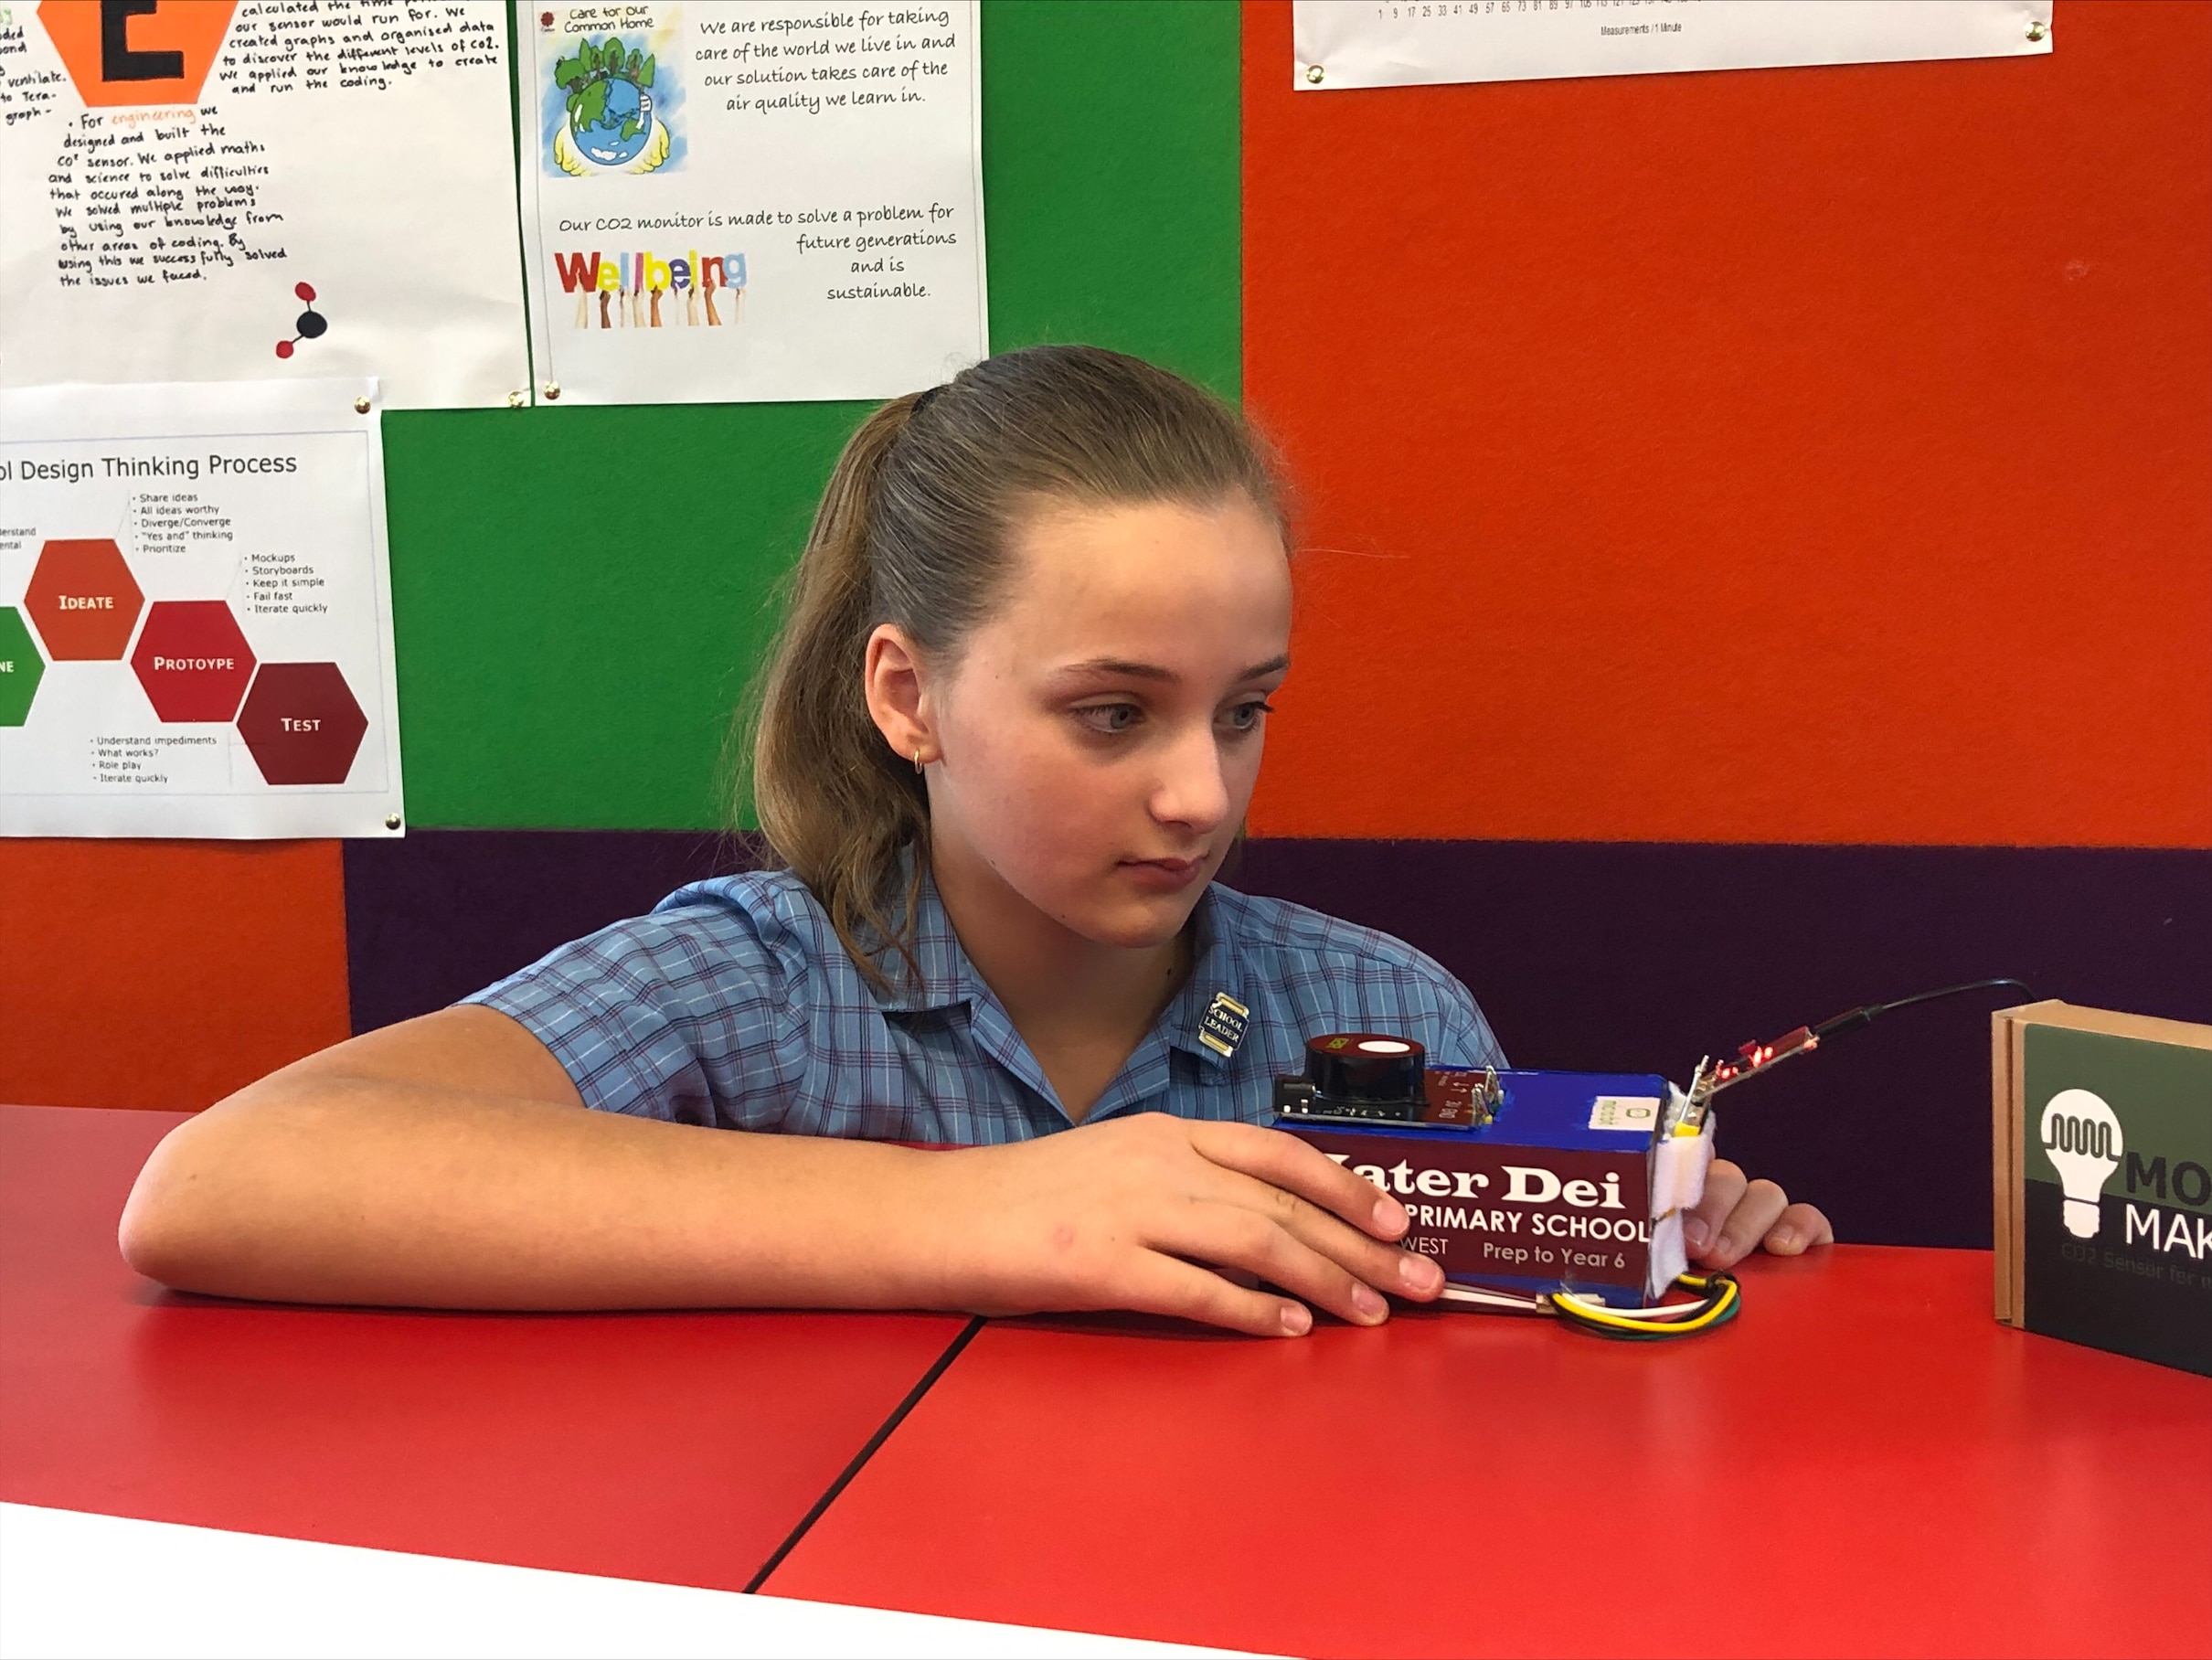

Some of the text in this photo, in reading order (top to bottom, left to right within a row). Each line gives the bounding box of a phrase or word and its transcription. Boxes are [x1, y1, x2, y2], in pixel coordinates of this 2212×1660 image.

[241, 2, 319, 17] calculated
[569, 8, 598, 19] Care
[602, 7, 622, 17] for
[235, 15, 399, 33] our sensor would run
[564, 21, 616, 34] Common
[621, 16, 654, 29] Home
[700, 6, 950, 37] We are responsible for taking
[229, 21, 495, 52] created graphs and organised data
[223, 39, 465, 66] to discover the levels of
[695, 33, 956, 63] care of the world we live in and
[249, 55, 498, 82] applied our to create
[704, 60, 948, 87] our solution takes care of the
[231, 79, 328, 94] and run the
[727, 86, 927, 115] air quality we learn in.
[80, 107, 197, 129] For engineering
[63, 122, 226, 154] designed and built the
[164, 142, 215, 165] applied
[48, 165, 269, 183] and science solve difficulties
[49, 185, 216, 201] that occured along the
[86, 197, 256, 216] solved problems
[89, 210, 283, 238] using our from
[558, 202, 954, 231] Our CO2 monitor is made to solve a problem for
[61, 239, 94, 251] other
[796, 229, 957, 254] future generations
[245, 248, 287, 261] solved
[850, 256, 905, 273] and is
[60, 273, 128, 287] the issues
[826, 282, 931, 300] sustainable.
[21, 459, 93, 484] Design
[101, 456, 199, 479] Thinking
[209, 454, 297, 474] Process
[140, 494, 197, 503] Share ideas
[141, 505, 219, 516] All ideas worthy
[141, 517, 231, 528] Diverge/Converge
[193, 531, 233, 541] thinking
[143, 544, 186, 553] Prioritize
[251, 554, 295, 564] Mockups
[252, 566, 314, 576] Storyboards
[253, 578, 324, 589] Keep it simple
[253, 592, 293, 601] Fail fast
[254, 603, 328, 614] Iterate quickly
[97, 736, 217, 746] Understand impediments
[98, 749, 159, 757] What works?
[99, 761, 142, 770] Role play
[101, 773, 168, 783] Iterate quickly
[1208, 1006, 1243, 1032] SCHOOL
[1204, 1016, 1239, 1043] LEADER
[1500, 1165, 1627, 1209] Dei
[1407, 1204, 1651, 1243] PRIMARY SCHOOL
[1483, 1242, 1529, 1265] Prep
[1535, 1245, 1554, 1263] to
[1559, 1248, 1608, 1268] Year
[1614, 1251, 1625, 1270] 6
